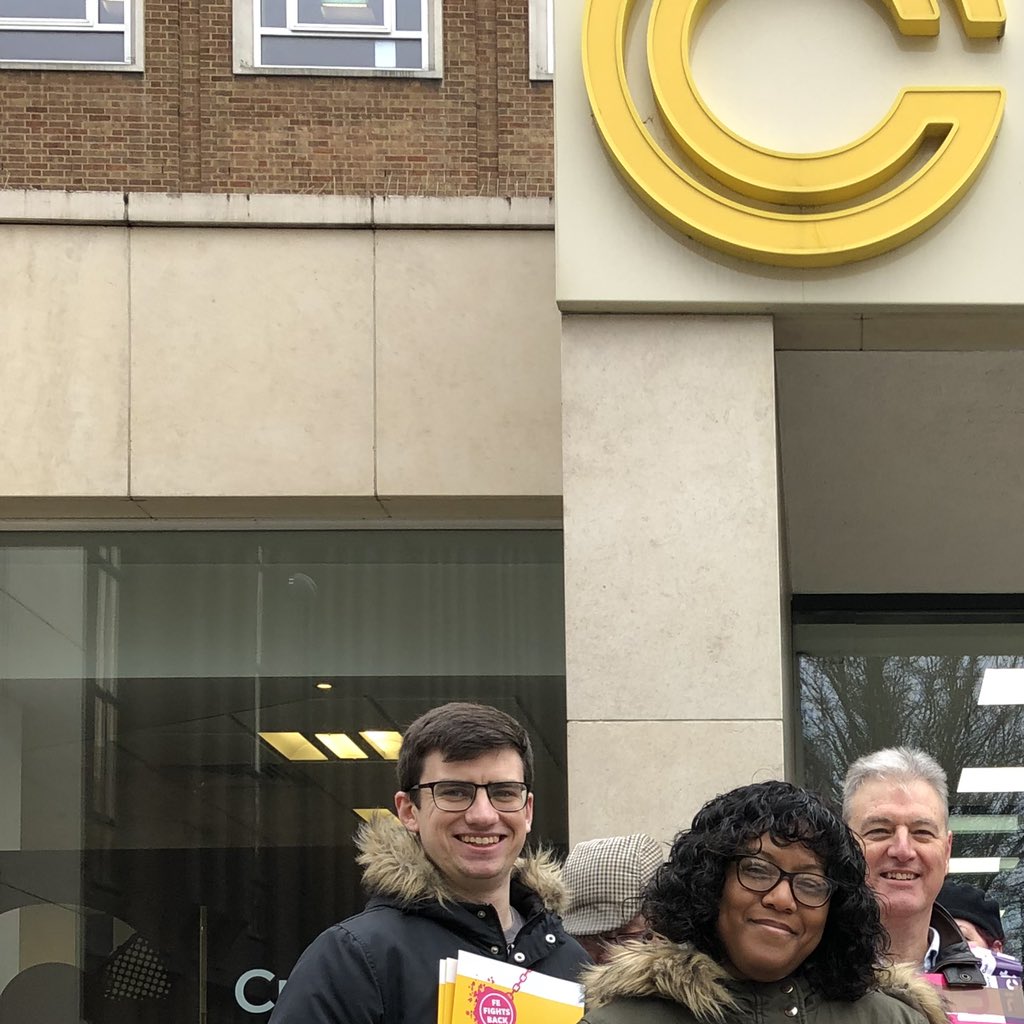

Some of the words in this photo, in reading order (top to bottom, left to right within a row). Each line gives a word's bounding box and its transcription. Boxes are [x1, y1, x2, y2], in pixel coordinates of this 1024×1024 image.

[491, 999, 501, 1007] FE
[483, 1007, 511, 1017] FIGHTS
[486, 1016, 508, 1024] BACK
